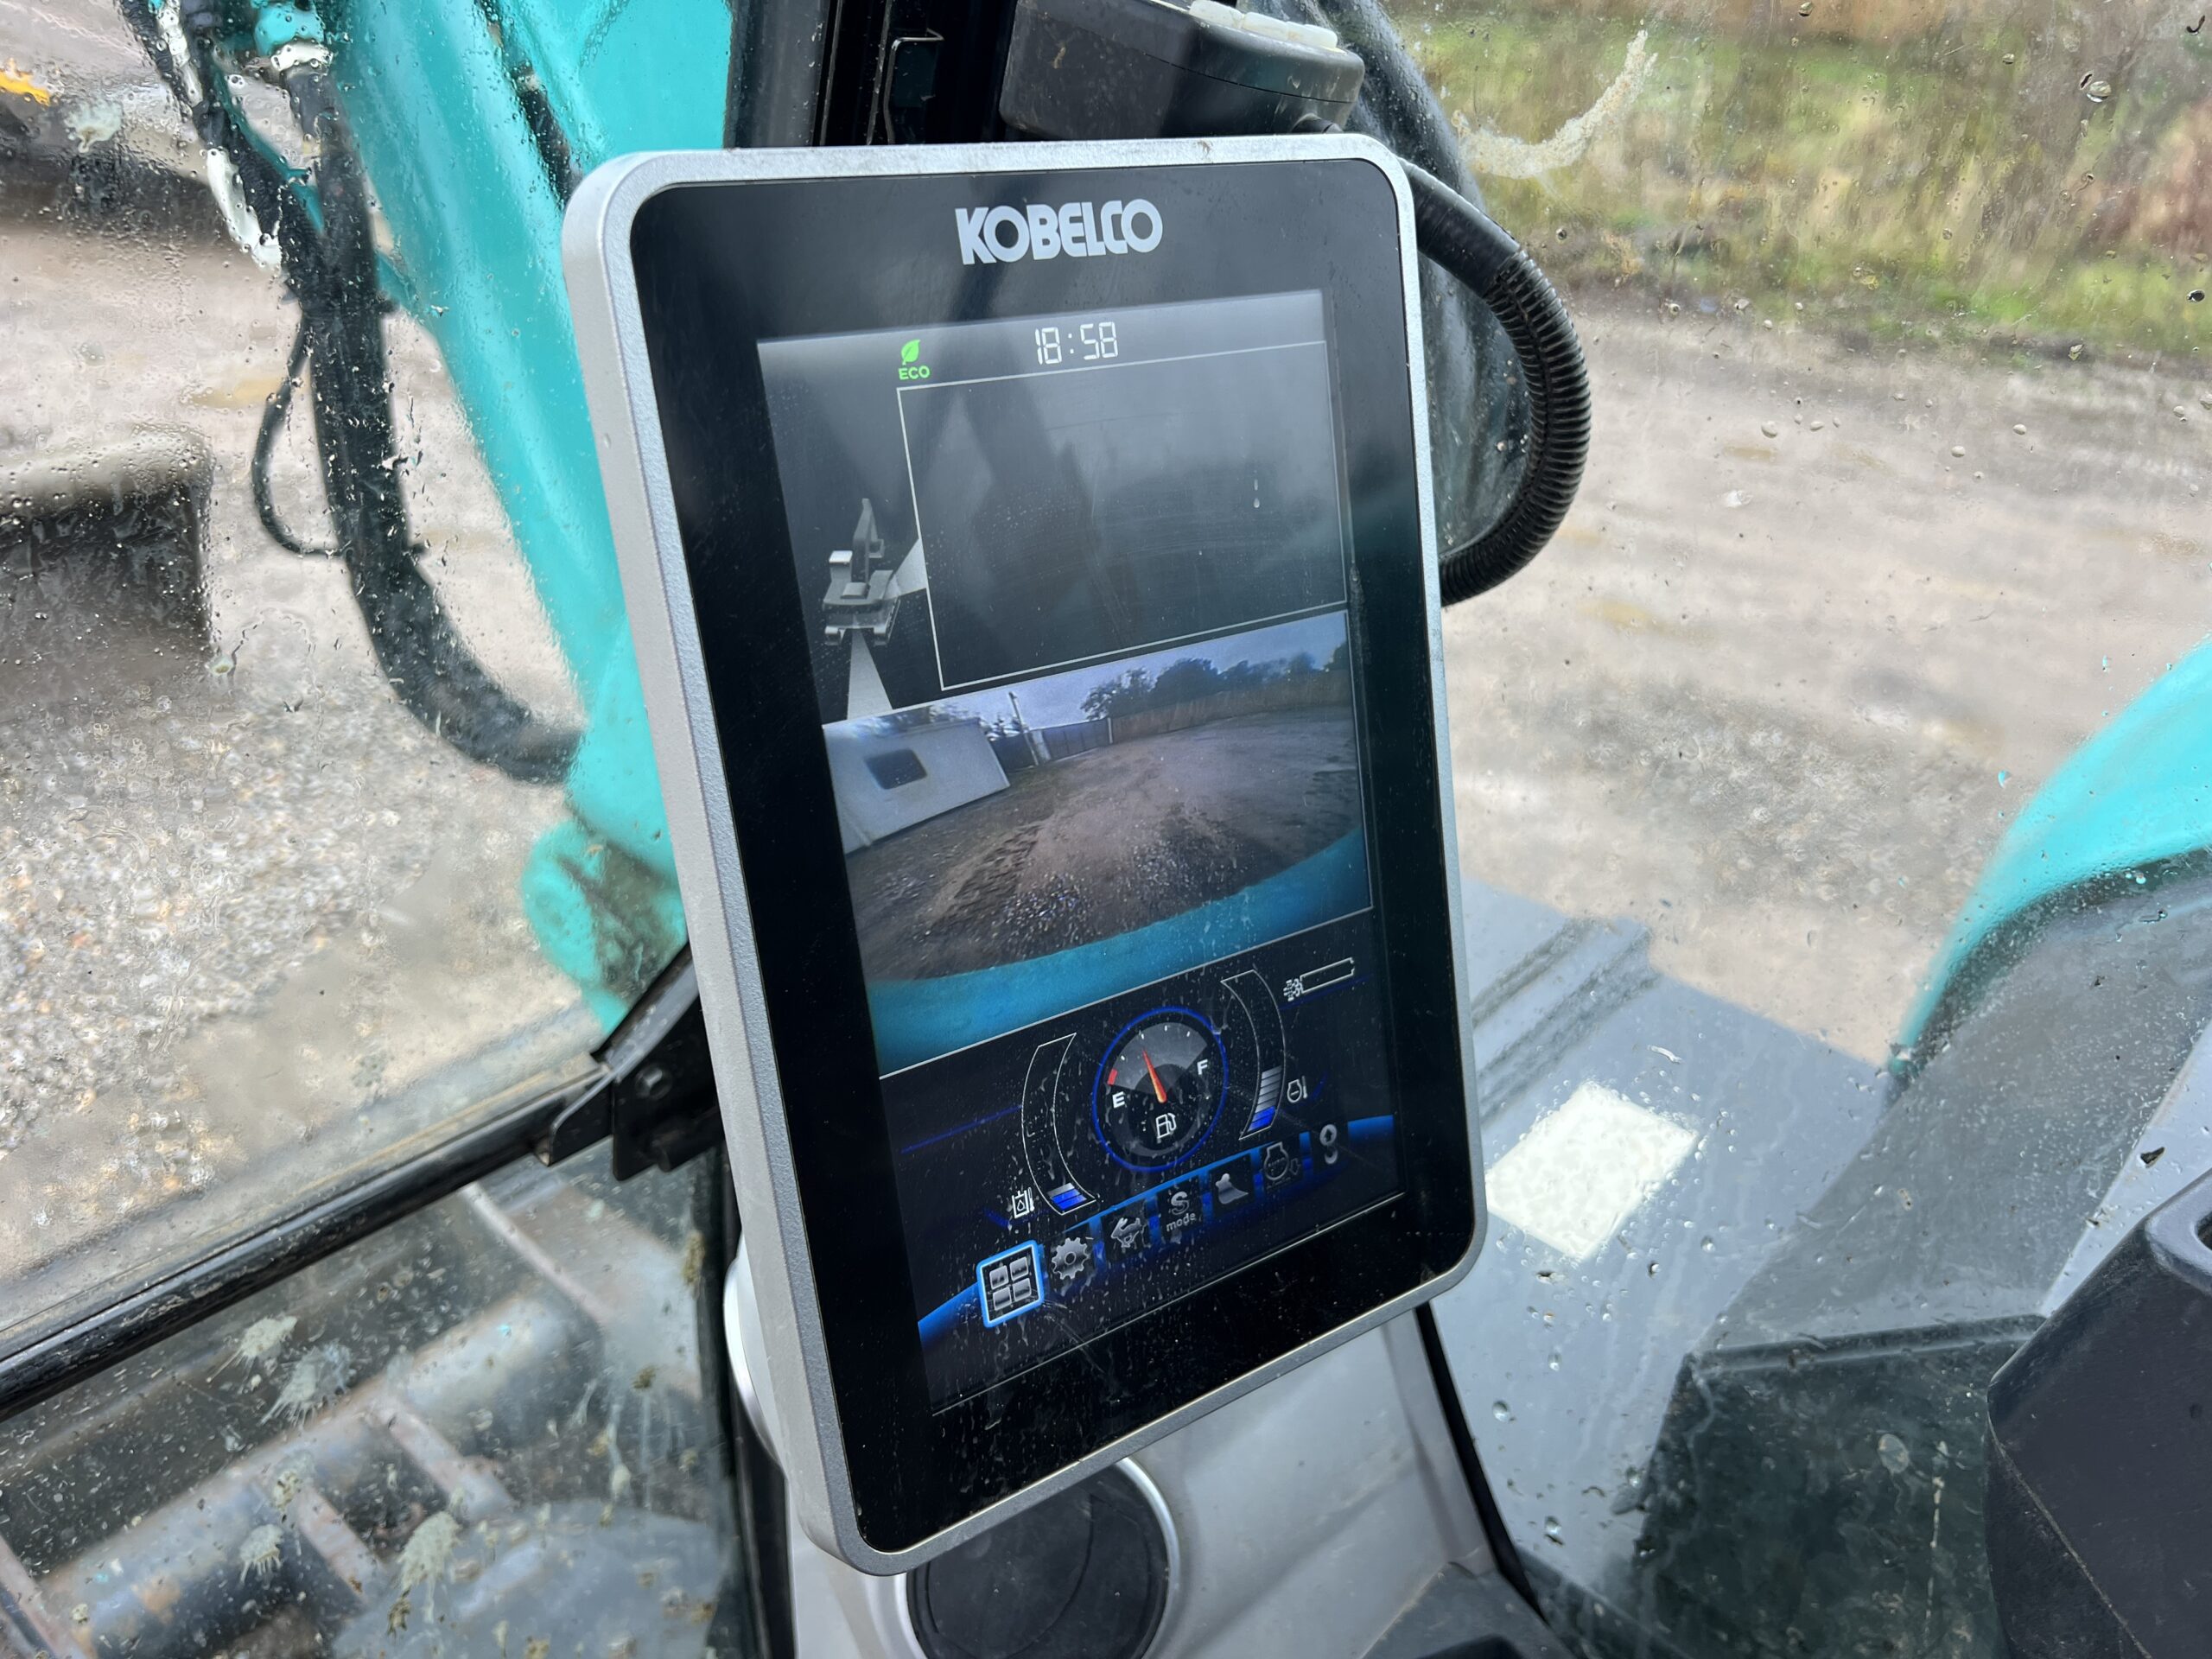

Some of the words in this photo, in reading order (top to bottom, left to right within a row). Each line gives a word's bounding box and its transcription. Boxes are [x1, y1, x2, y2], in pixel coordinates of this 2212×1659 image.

[955, 199, 1163, 265] KOBELCO
[1035, 321, 1119, 365] 18:58
[898, 365, 931, 380] ECO
[1197, 1058, 1209, 1076] F
[1112, 1090, 1126, 1109] E
[1171, 1191, 1190, 1216] S
[1166, 1212, 1197, 1232] mode
